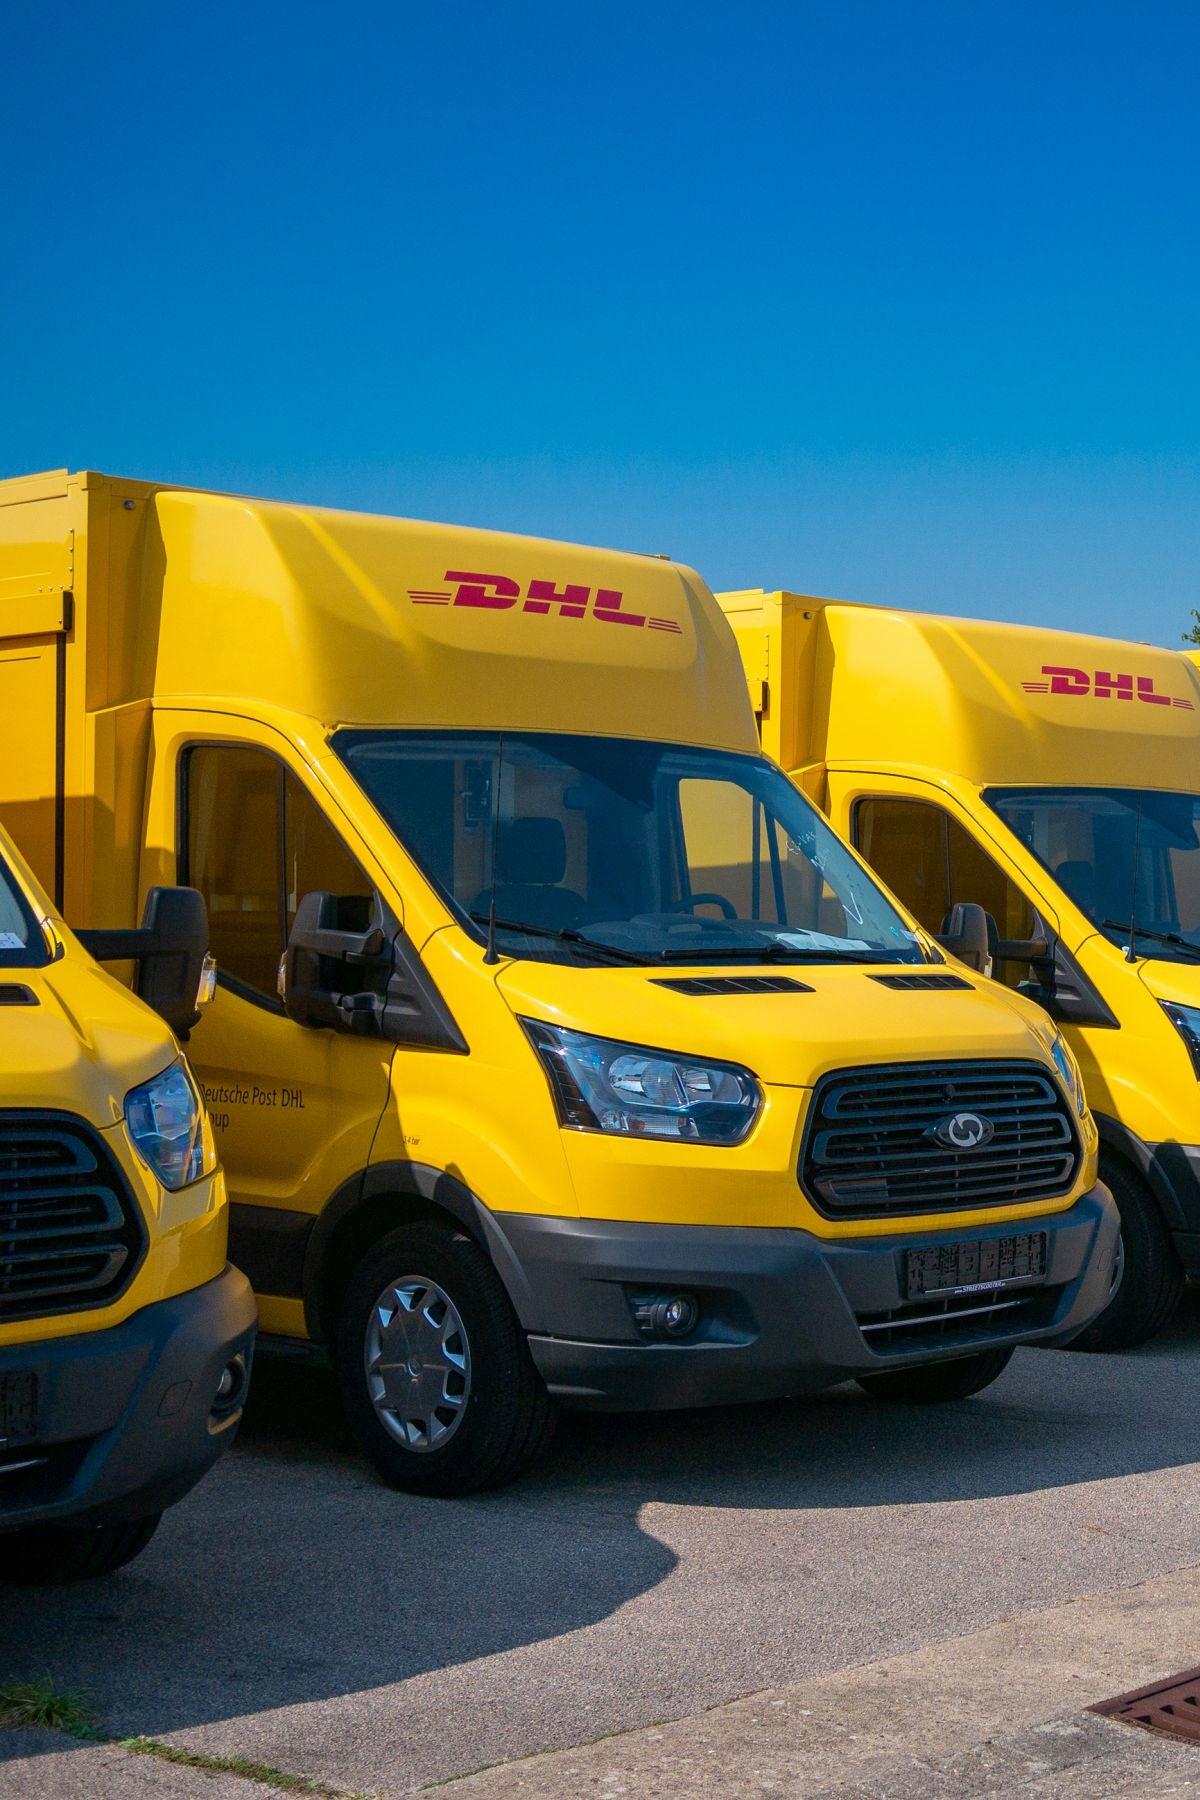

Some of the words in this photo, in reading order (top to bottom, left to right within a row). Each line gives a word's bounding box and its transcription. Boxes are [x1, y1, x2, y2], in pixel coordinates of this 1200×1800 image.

[444, 570, 646, 627] DHL
[1042, 665, 1171, 705] DHL
[251, 1086, 277, 1107] Post
[281, 1088, 305, 1109] DHL
